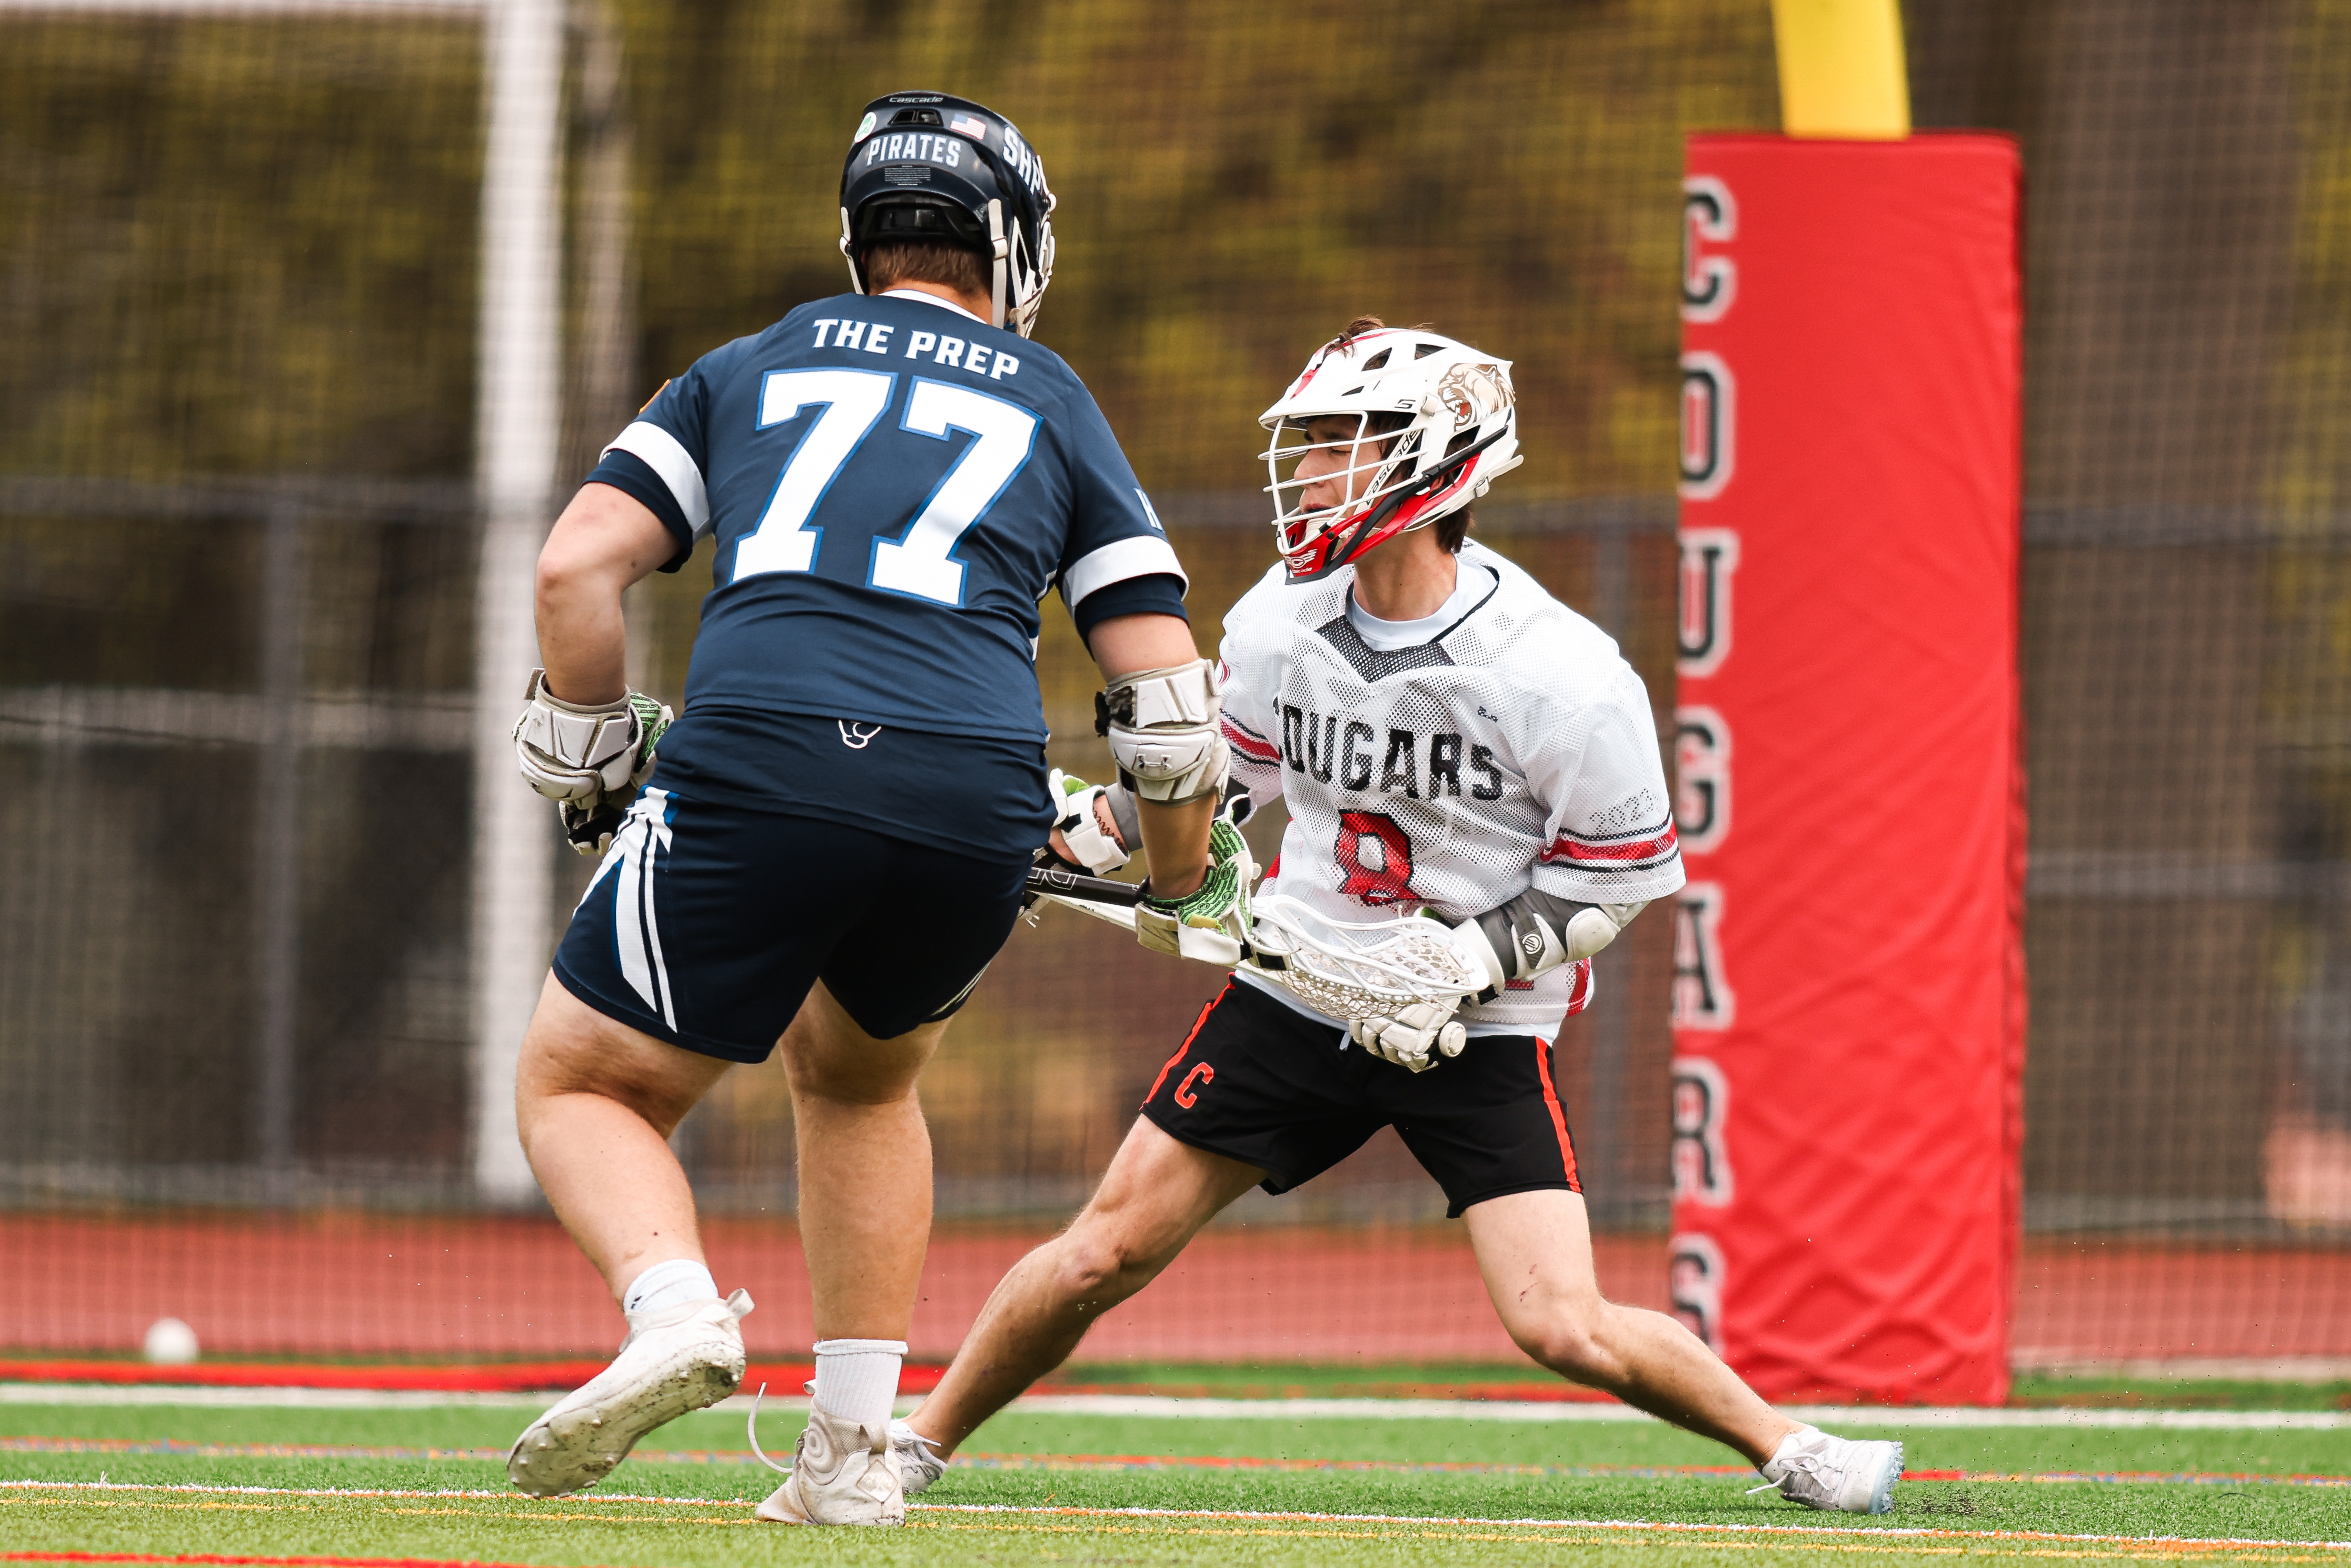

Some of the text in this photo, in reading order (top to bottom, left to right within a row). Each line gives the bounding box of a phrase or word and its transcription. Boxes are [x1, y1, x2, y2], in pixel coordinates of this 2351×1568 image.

[866, 134, 961, 168] PIRATES
[812, 318, 1020, 381] THE PREP
[729, 367, 1044, 608] 77
[1273, 696, 1503, 800] OUGARS
[1174, 1062, 1214, 1109] C
